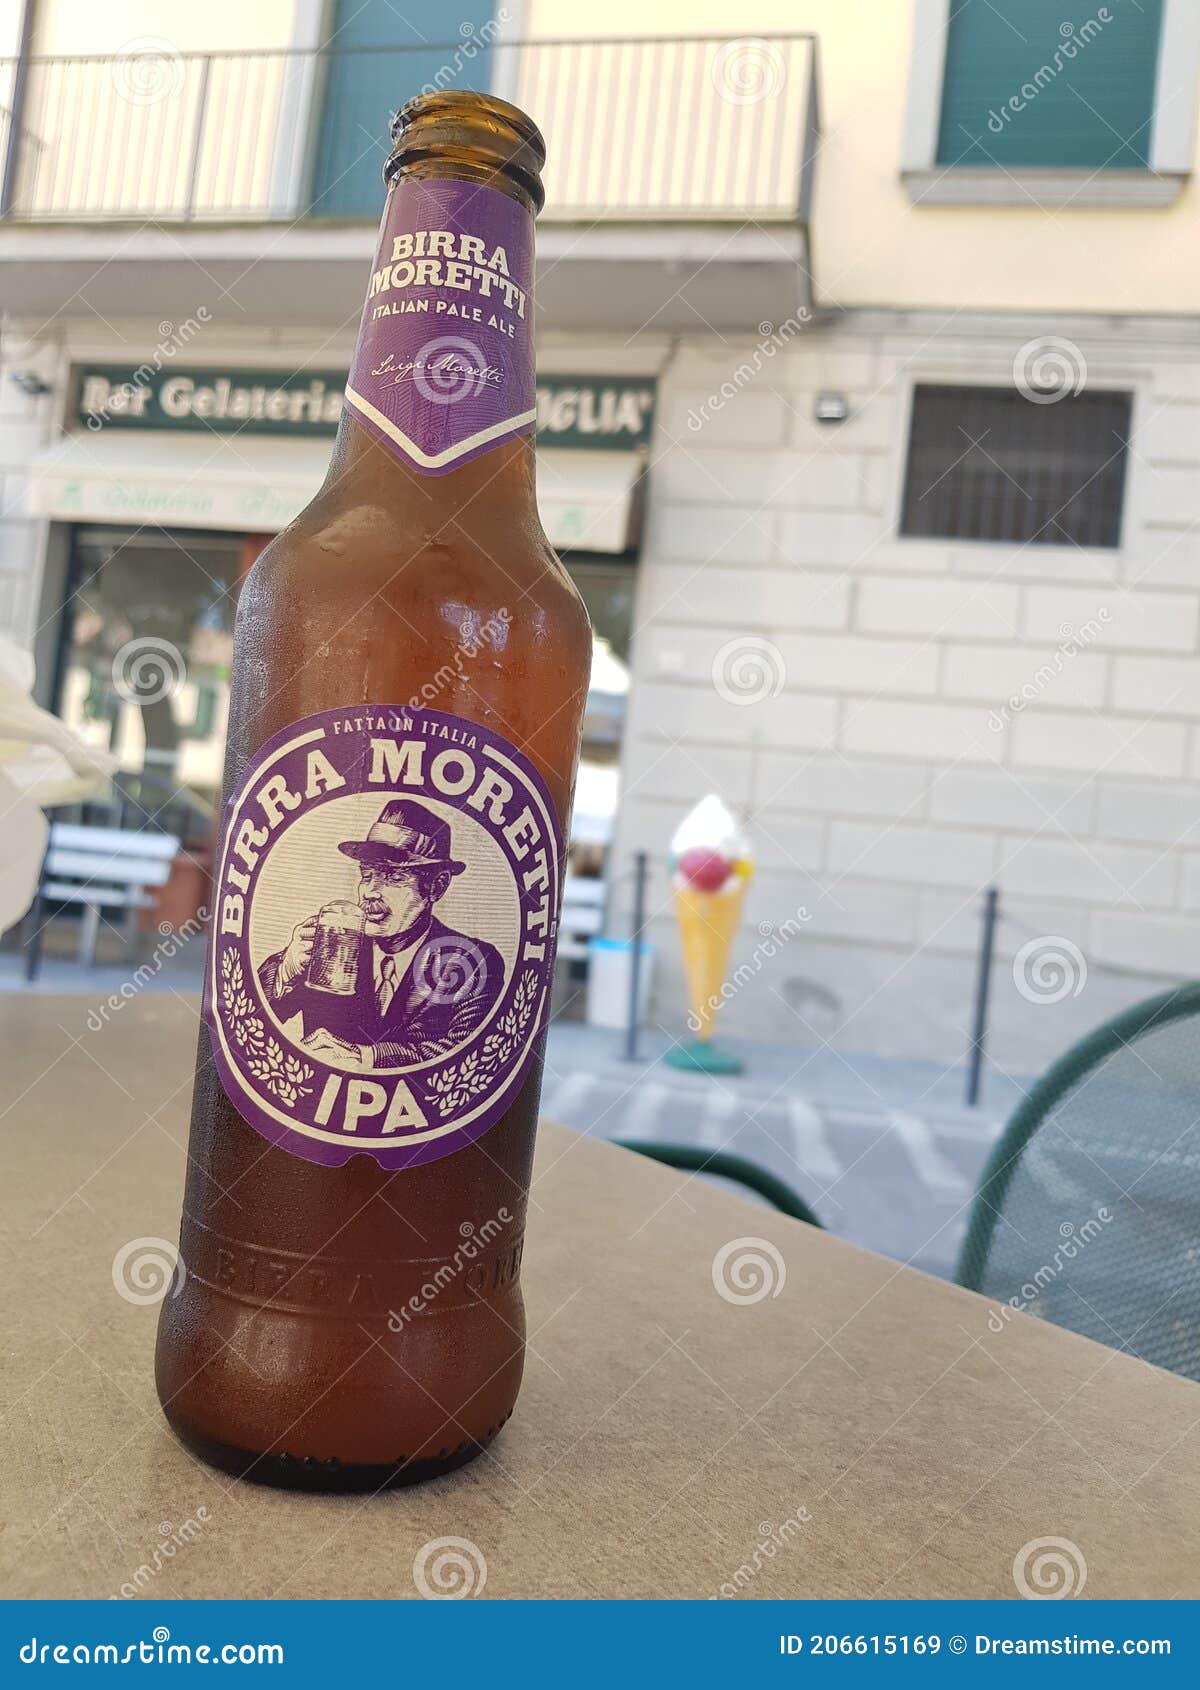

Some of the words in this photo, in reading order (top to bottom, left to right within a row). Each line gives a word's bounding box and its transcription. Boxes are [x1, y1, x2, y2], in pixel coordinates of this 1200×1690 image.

[391, 231, 510, 277] BIRRA
[369, 259, 527, 320] MORETTI
[372, 299, 429, 320] ITALIAN
[436, 301, 482, 322] PALE
[488, 315, 516, 339] ALE
[371, 354, 425, 383] Luigi
[427, 353, 505, 383] Moretti
[82, 375, 152, 417] Bar
[158, 376, 345, 422] Gelateria
[334, 717, 386, 735] FATTA
[395, 717, 413, 732] IN
[421, 720, 477, 749] ITALIA
[221, 749, 346, 938] BIRRA
[368, 738, 550, 962] MORETTI
[314, 1073, 429, 1134] IPA
